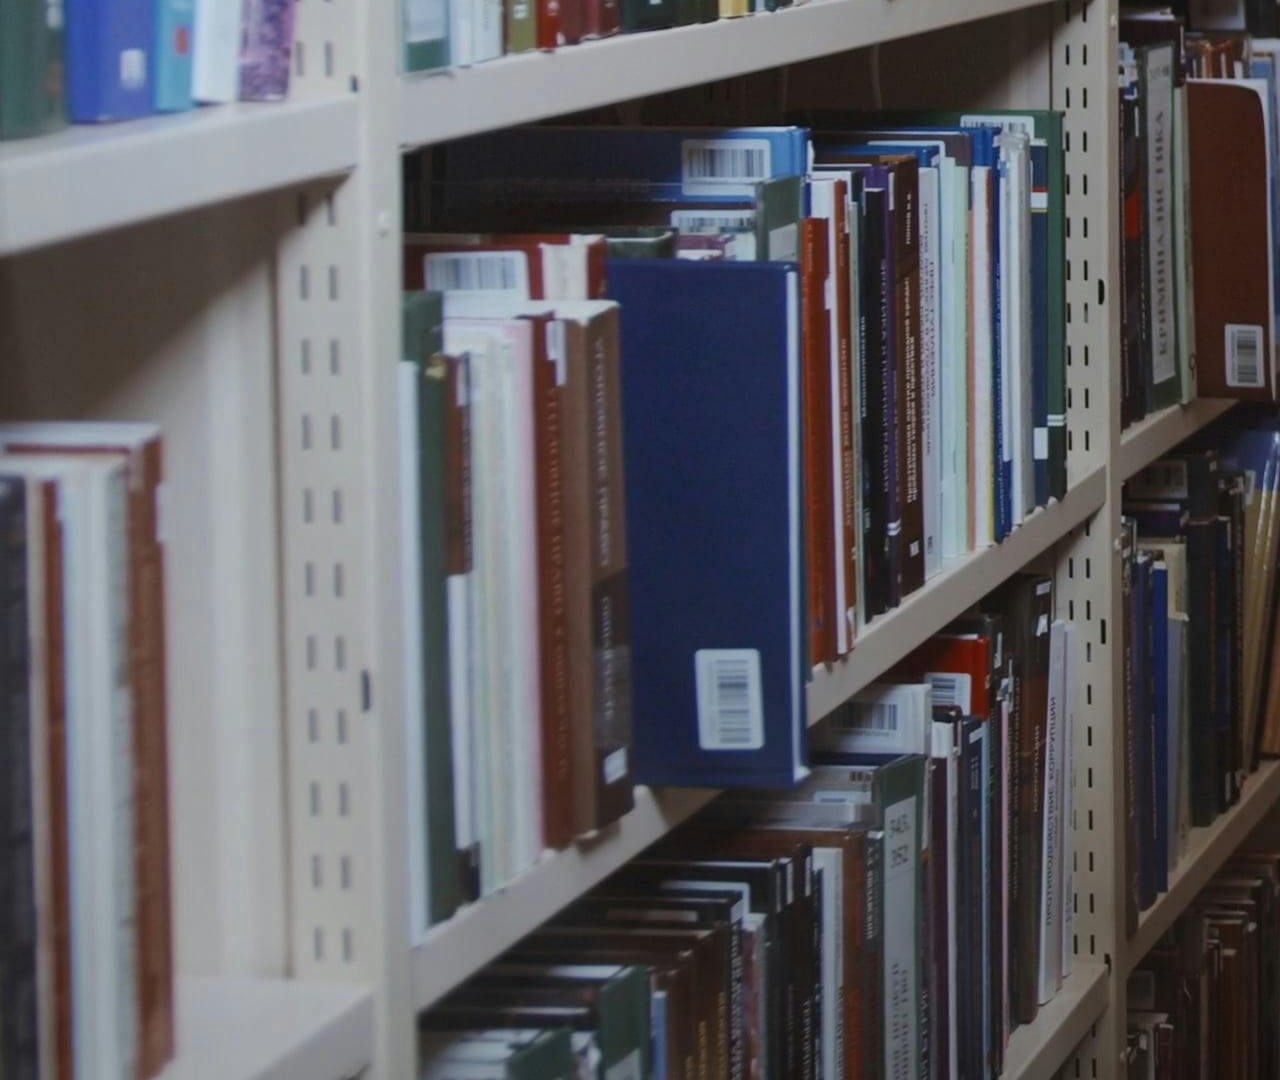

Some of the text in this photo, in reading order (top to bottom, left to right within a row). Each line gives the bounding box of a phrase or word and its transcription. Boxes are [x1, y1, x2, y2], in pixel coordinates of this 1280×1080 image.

[1156, 111, 1168, 356] КРИМИНАЛИСТИКА
[593, 337, 607, 480] УГОЛОВНОЕ
[595, 487, 610, 567] ПРАВО
